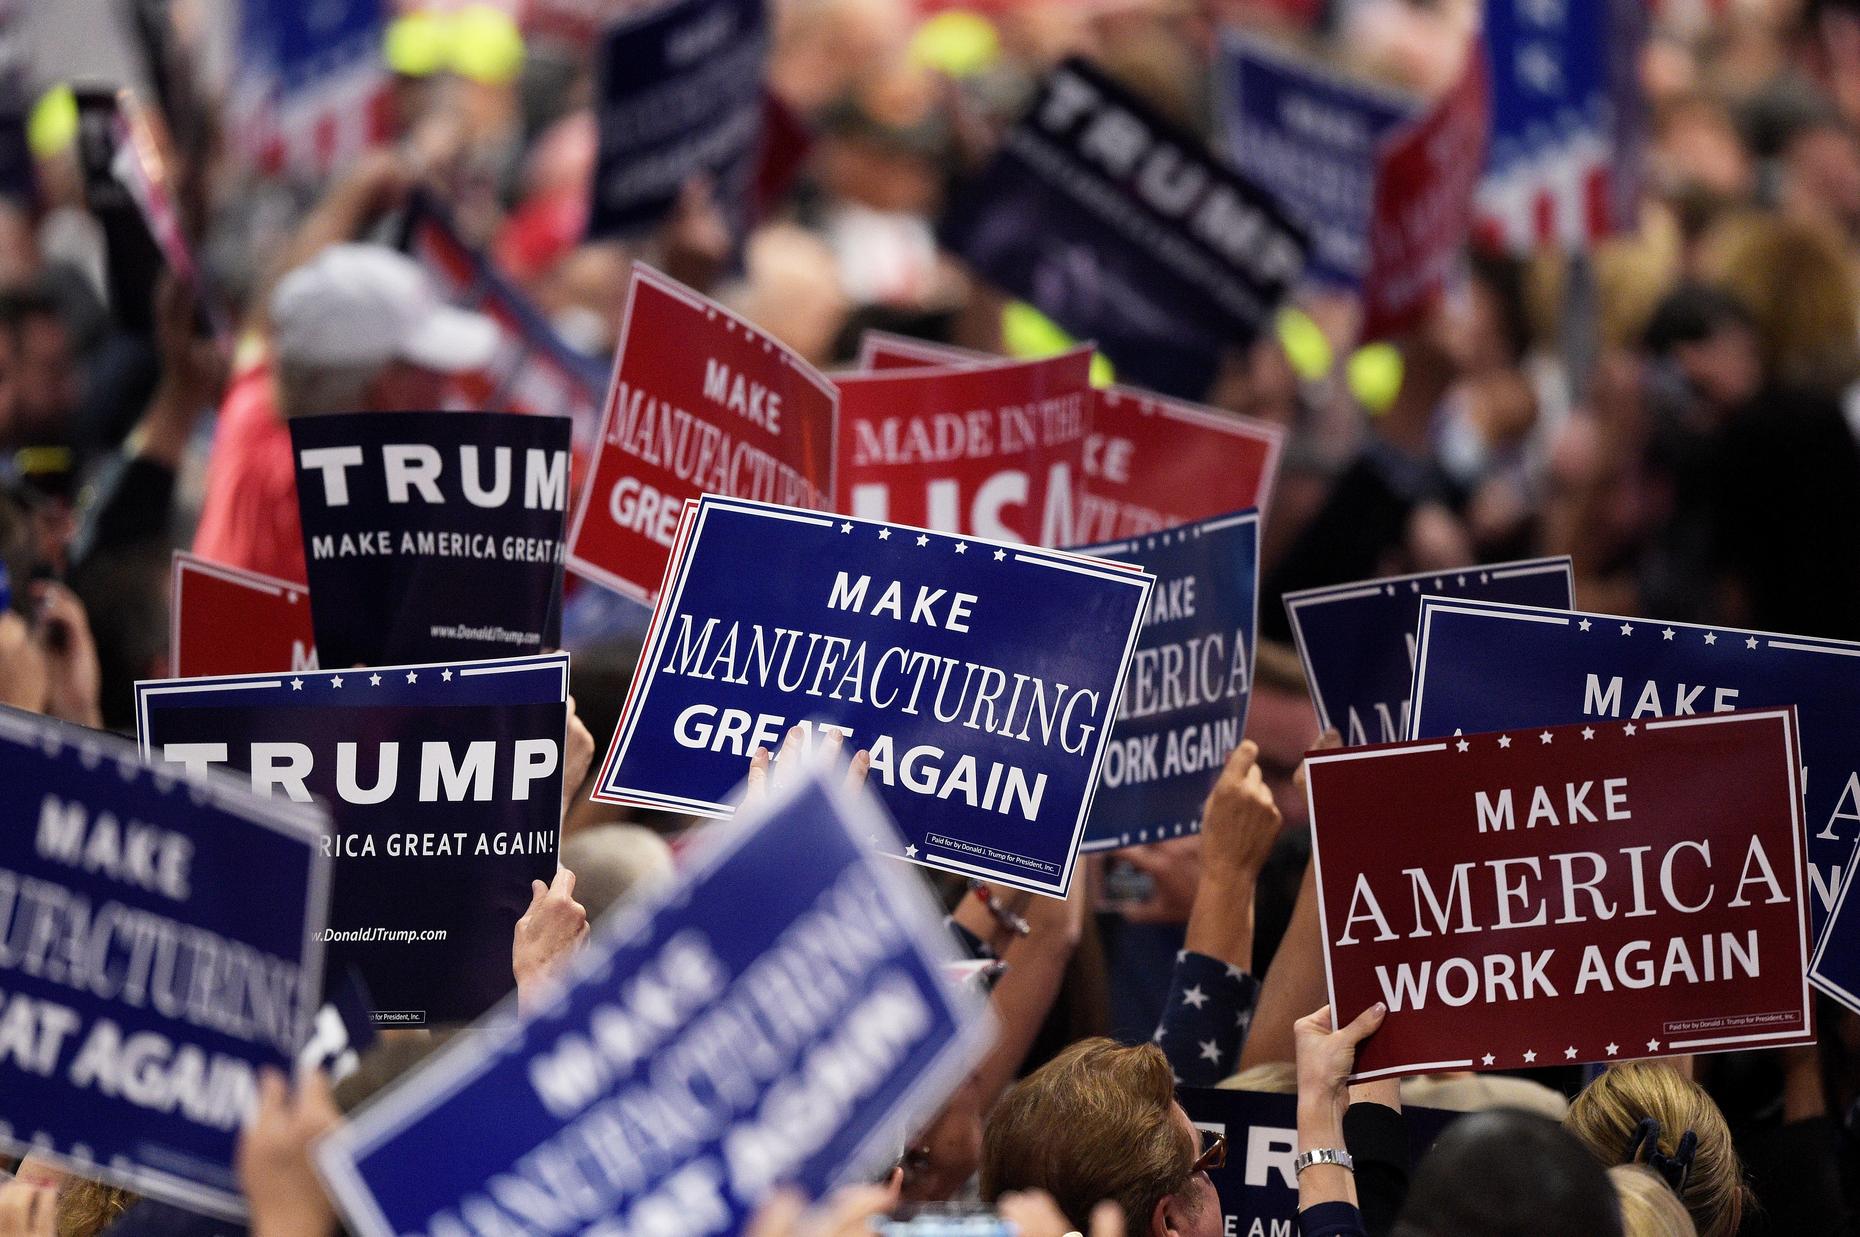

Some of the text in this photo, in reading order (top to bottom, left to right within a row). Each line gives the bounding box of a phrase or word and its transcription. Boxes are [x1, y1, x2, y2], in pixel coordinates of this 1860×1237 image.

[703, 357, 782, 436] MAKE
[605, 380, 836, 512] MANUFACTUR
[853, 410, 994, 467] MADE
[1082, 433, 1134, 483] KE
[300, 444, 572, 511] TRUM
[608, 475, 684, 548] GRE
[312, 531, 393, 560] MAKE
[400, 531, 497, 560] AMERICA
[502, 536, 553, 563] GREAT
[430, 624, 541, 645] www.DonaldJTrump.com
[827, 571, 979, 634] MAKE
[662, 614, 1100, 757] MANUFACTURING
[1117, 628, 1250, 722] ERICA
[1583, 673, 1740, 720] MAKE
[163, 738, 559, 805] TRUMP
[673, 704, 1048, 822] GREAT AGAIN
[1103, 717, 1238, 789] ORK AGAIN
[1474, 777, 1632, 833] MAKE
[36, 792, 195, 902] MAKE
[319, 830, 554, 858] RICA GREAT AGAIN!
[931, 836, 944, 845] Paid
[953, 841, 961, 850] by
[961, 843, 982, 854] Donald
[988, 850, 1006, 860] Trump
[1015, 856, 1043, 869] President,
[1044, 864, 1055, 872] Inc.
[1335, 834, 1791, 947] AMERICA
[0, 868, 308, 1056] UFACTURIN
[311, 927, 447, 944] w.DonaldJTrump.com
[1375, 929, 1761, 1013] WORK AGAIN
[375, 1012, 383, 1020] for
[1669, 1023, 1682, 1031] Paid
[1682, 1023, 1691, 1031] for
[1691, 1022, 1700, 1030] by
[1700, 1020, 1721, 1028] Donald
[1727, 1018, 1746, 1026] Trump
